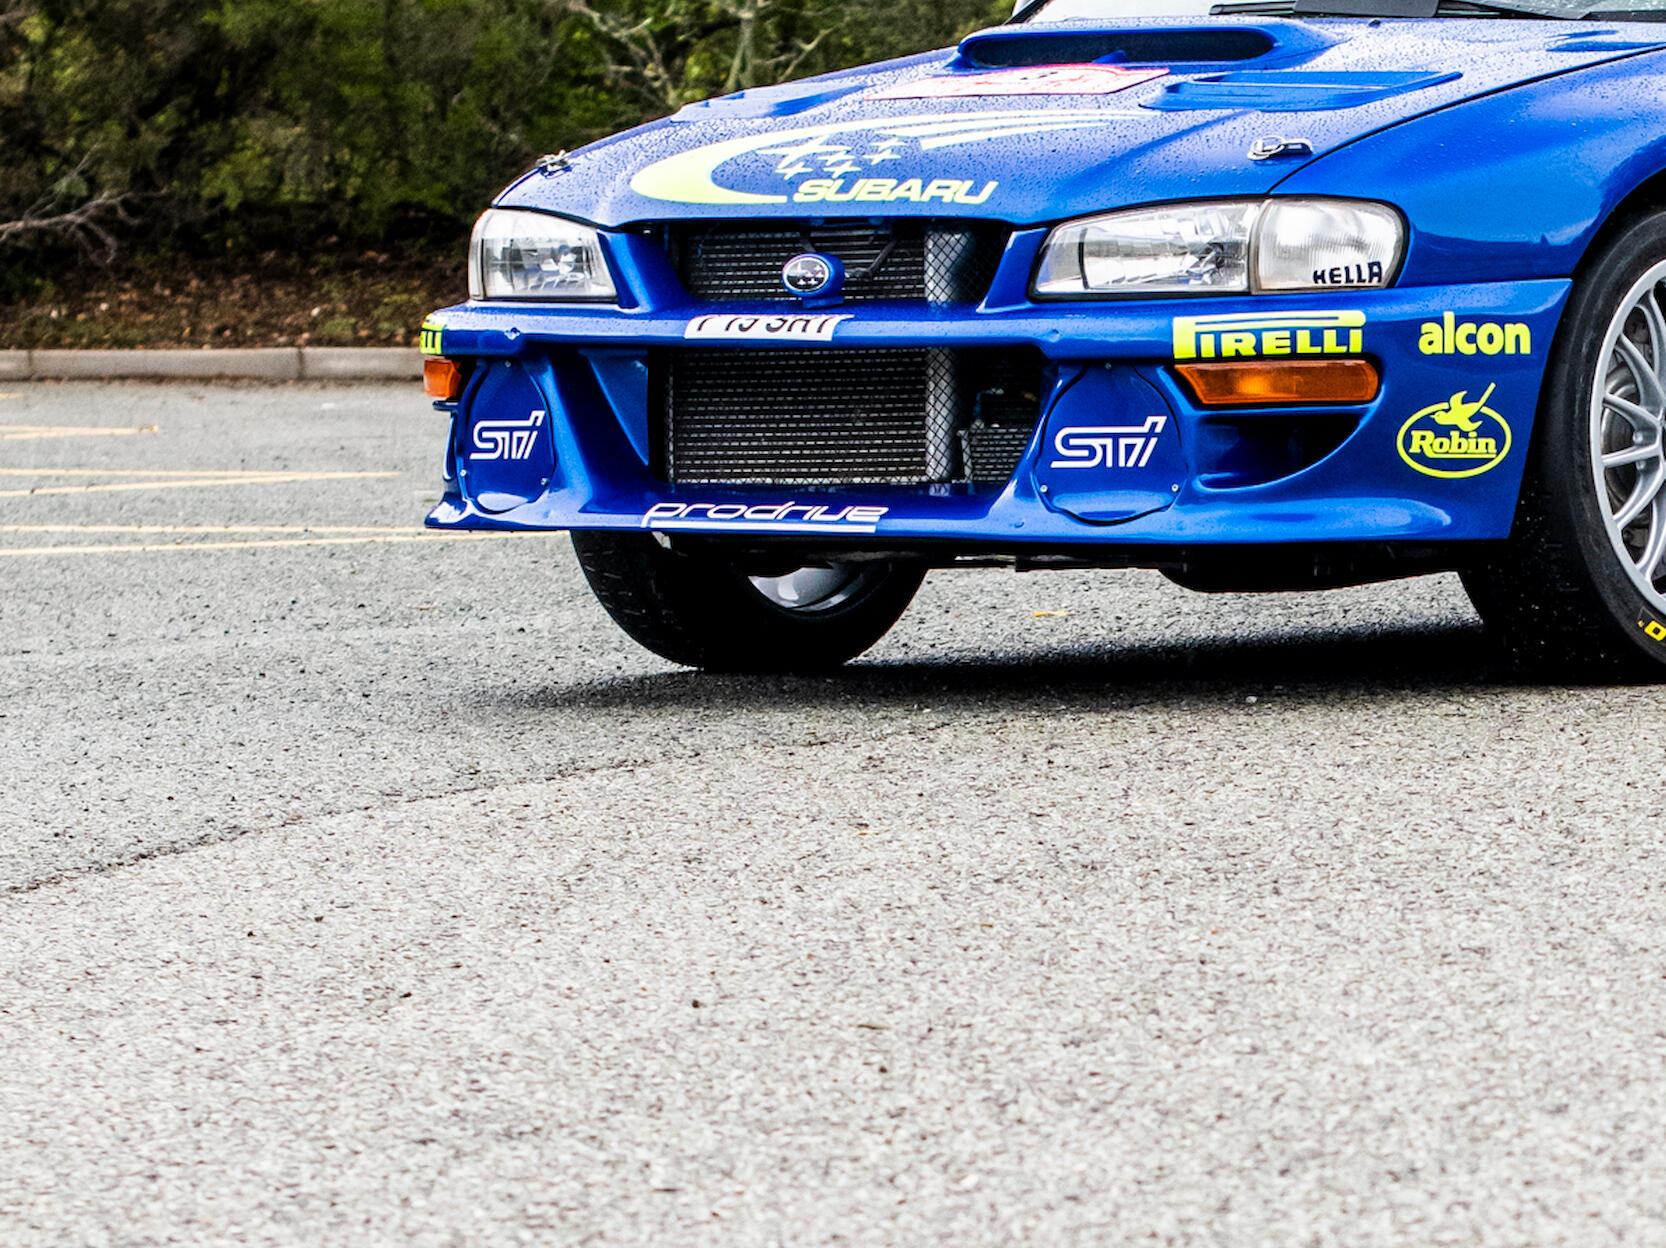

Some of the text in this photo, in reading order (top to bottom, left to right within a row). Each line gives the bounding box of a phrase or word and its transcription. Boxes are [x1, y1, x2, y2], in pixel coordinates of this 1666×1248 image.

[793, 178, 998, 205] SUBARU
[1312, 260, 1383, 286] HELLA
[1173, 310, 1366, 359] PIRELLI
[1419, 311, 1531, 355] alcon
[1409, 429, 1497, 459] Robin
[641, 500, 889, 528] prodrive
